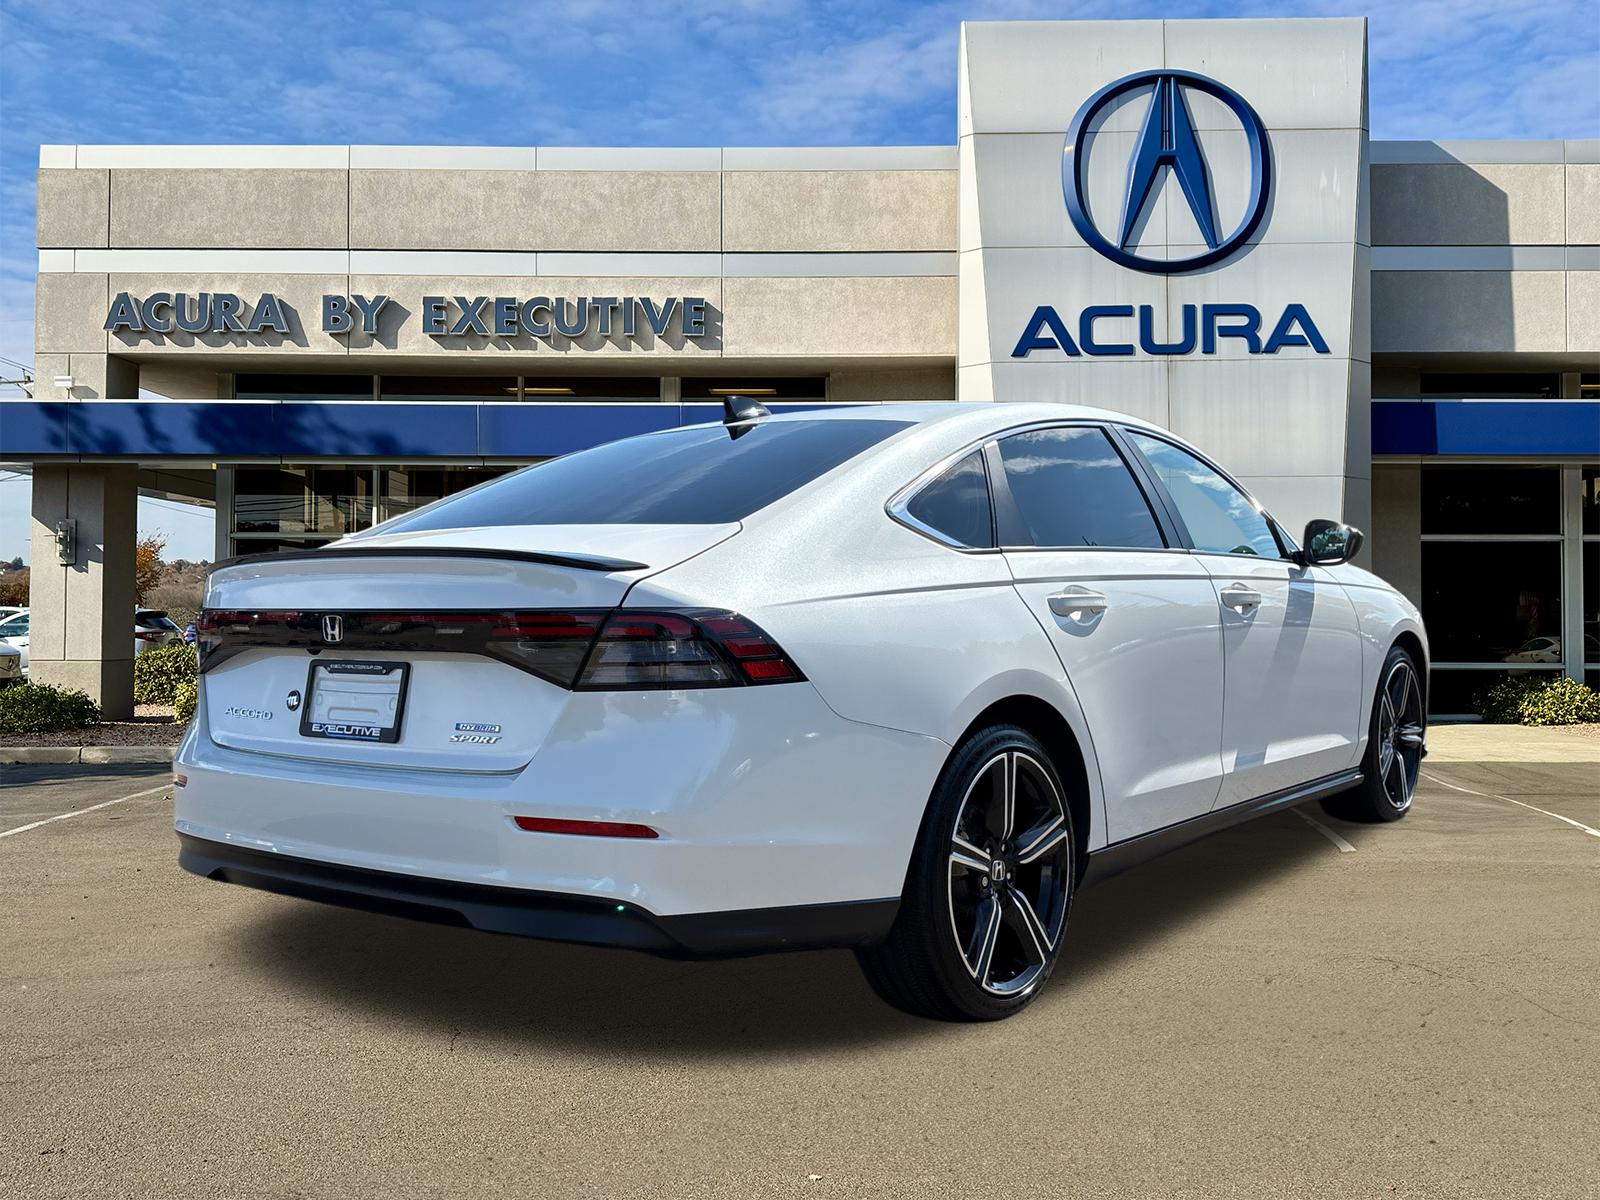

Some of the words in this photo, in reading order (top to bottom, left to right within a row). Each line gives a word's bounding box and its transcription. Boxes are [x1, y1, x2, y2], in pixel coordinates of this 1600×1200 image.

[103, 292, 290, 333] ACURA
[322, 294, 389, 334] BY
[422, 296, 706, 337] EXECUTIVE
[1011, 303, 1332, 358] ACURA
[225, 706, 273, 720] ACCORD
[311, 723, 381, 737] EXECUTIVE
[458, 723, 501, 733] HYBRID
[449, 735, 503, 744] SPORT
